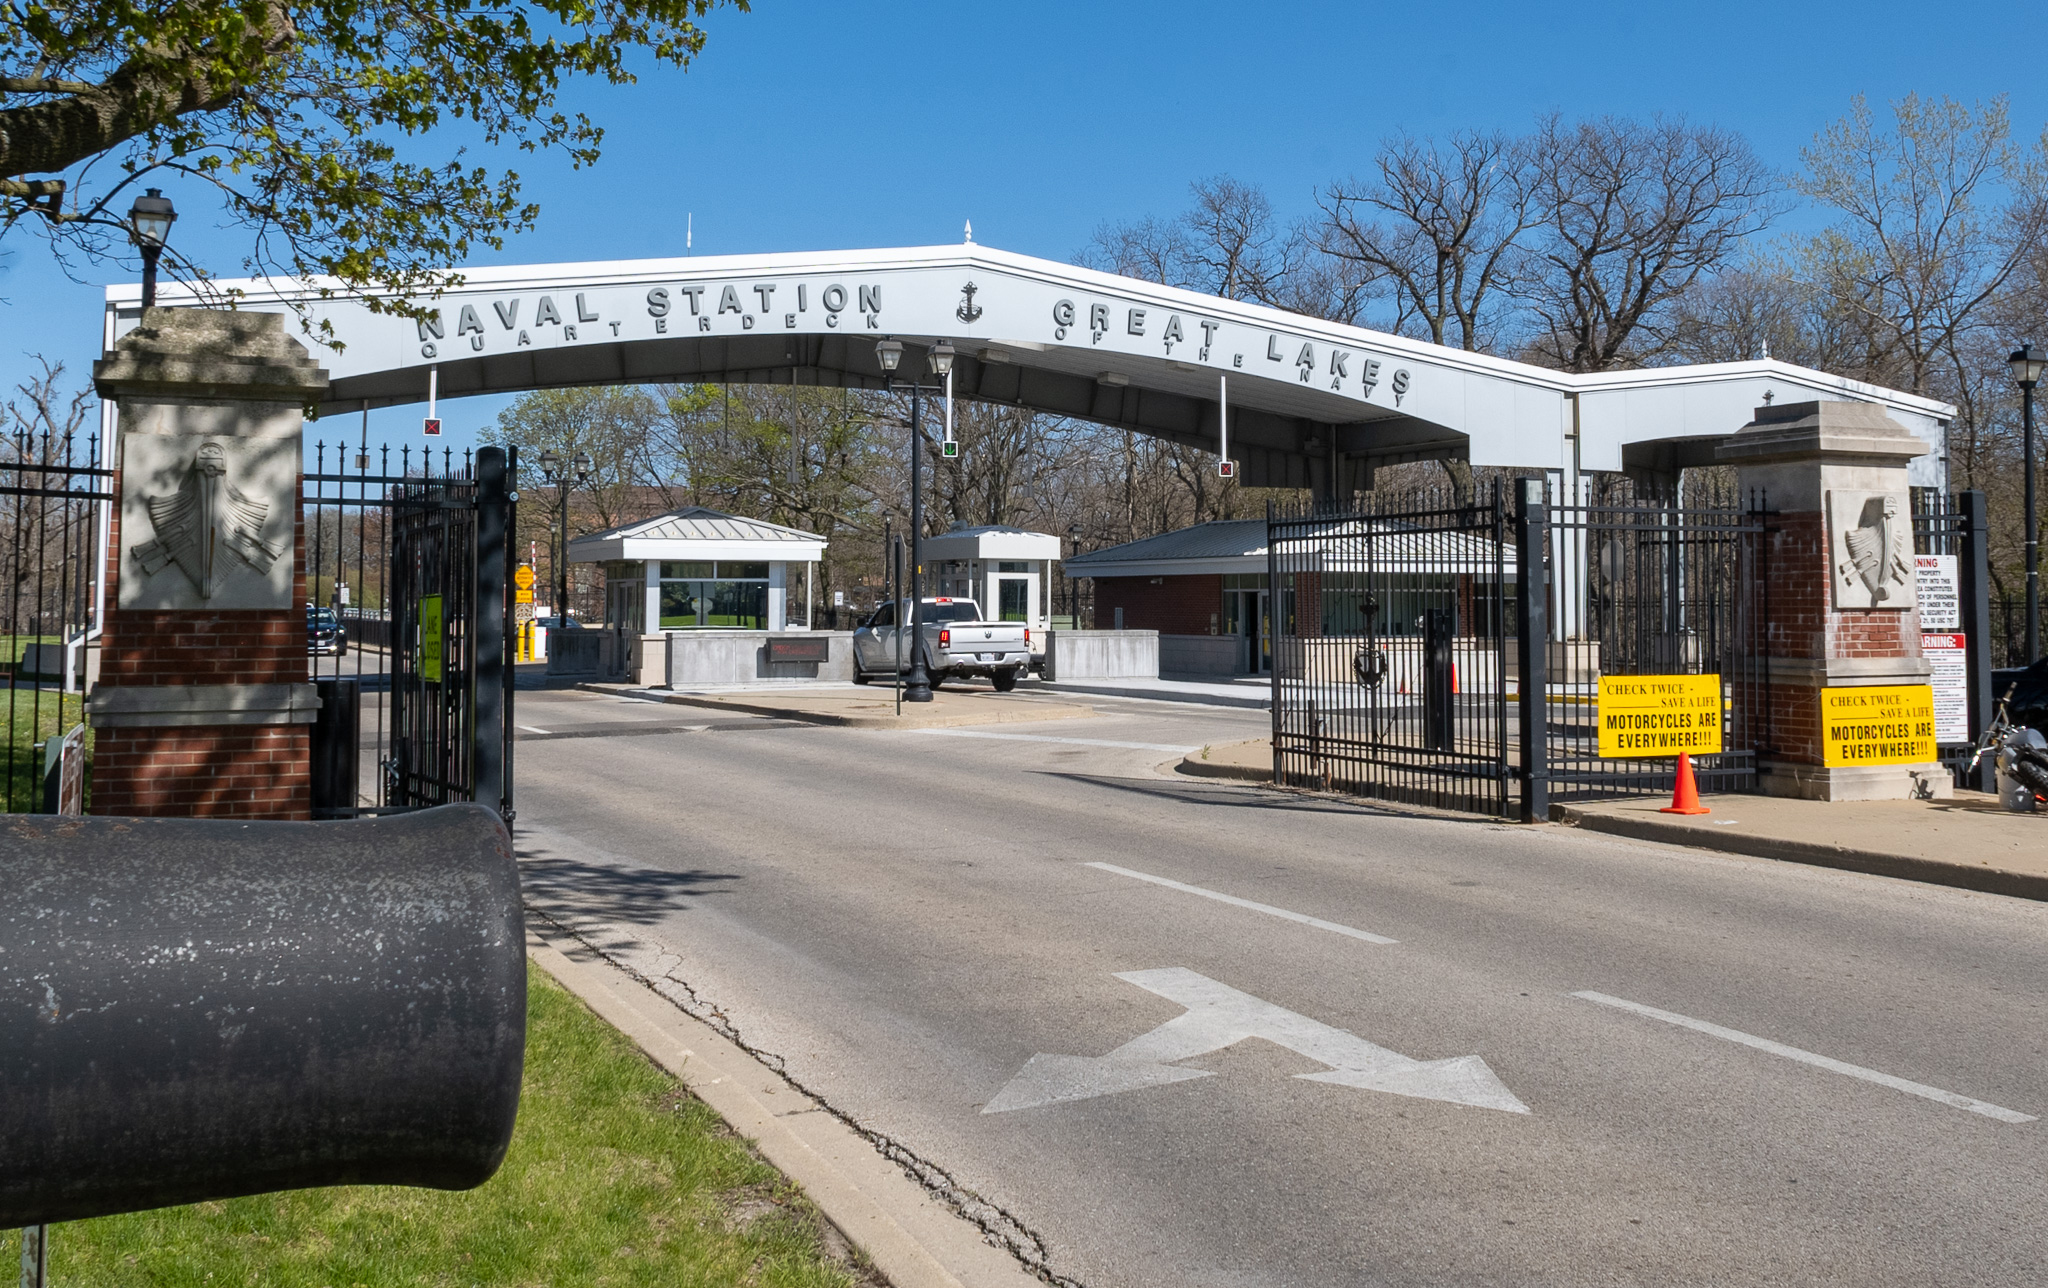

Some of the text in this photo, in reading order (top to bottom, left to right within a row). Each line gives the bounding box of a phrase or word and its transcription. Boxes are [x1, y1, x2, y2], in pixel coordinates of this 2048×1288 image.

[416, 283, 1411, 394] NAVAL STATION GREAT LAKES
[421, 313, 1404, 408] QUARTERDECK OF THE NAVY
[1914, 558, 1938, 568] NING
[1607, 684, 1647, 695] CHECK
[1650, 684, 1685, 694] TWICE
[1661, 696, 1716, 708] SAVE A LIFE
[1830, 696, 1867, 707] CHECK
[1870, 695, 1901, 705] TWICE
[1607, 712, 1716, 729] MOTORCYCLES ARE
[1880, 707, 1930, 719] SAVE A LIFE
[1618, 731, 1711, 748] EVERYWHERE!!!
[1831, 722, 1932, 741] MOTORCYCLES ARE
[1842, 741, 1928, 759] EVERYWHERE!!!
